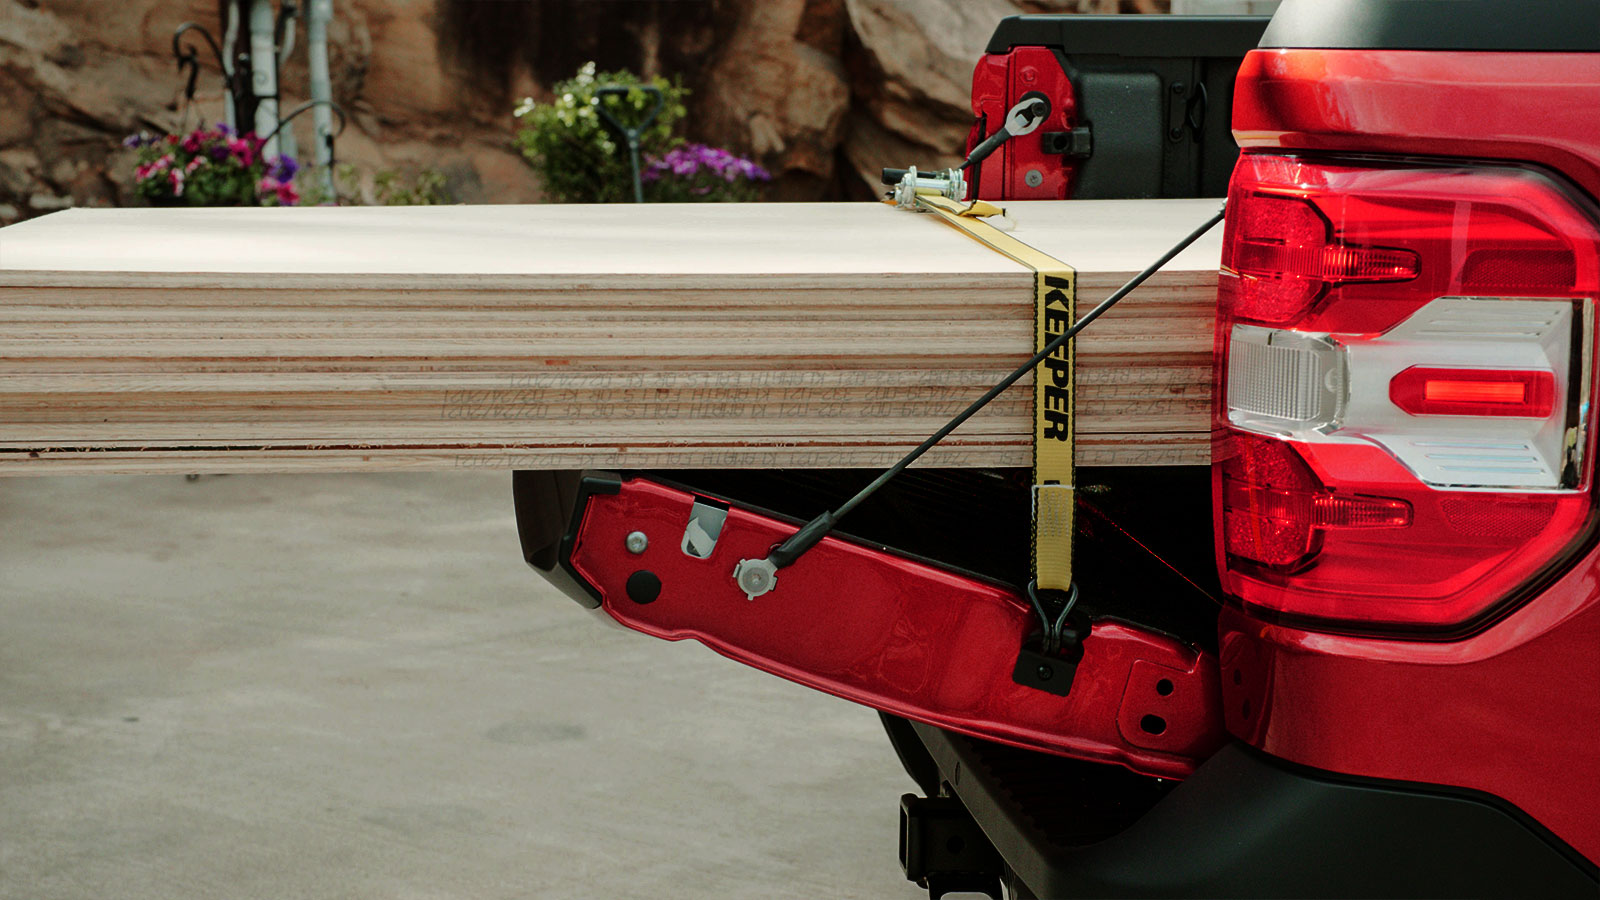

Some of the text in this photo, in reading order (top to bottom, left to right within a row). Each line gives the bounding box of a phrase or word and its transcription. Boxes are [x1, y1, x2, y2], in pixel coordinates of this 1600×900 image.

[1044, 275, 1070, 442] KEEPER
[687, 372, 741, 388] FALLS
[751, 371, 825, 387] KLAMATH
[443, 389, 546, 405] 02/24/2021
[588, 388, 613, 404] OR
[622, 388, 682, 403] FALLS
[693, 387, 770, 403] KLAMATH
[440, 403, 550, 419] 02/24/2021
[562, 403, 583, 419] KF
[591, 403, 615, 419] OR
[624, 403, 681, 419] FALLS
[690, 402, 767, 419] KLAMATH
[455, 454, 562, 469] 02/24/2021
[605, 453, 627, 468] OR
[636, 453, 692, 468] FALLS
[701, 452, 777, 468] KLAMATH
